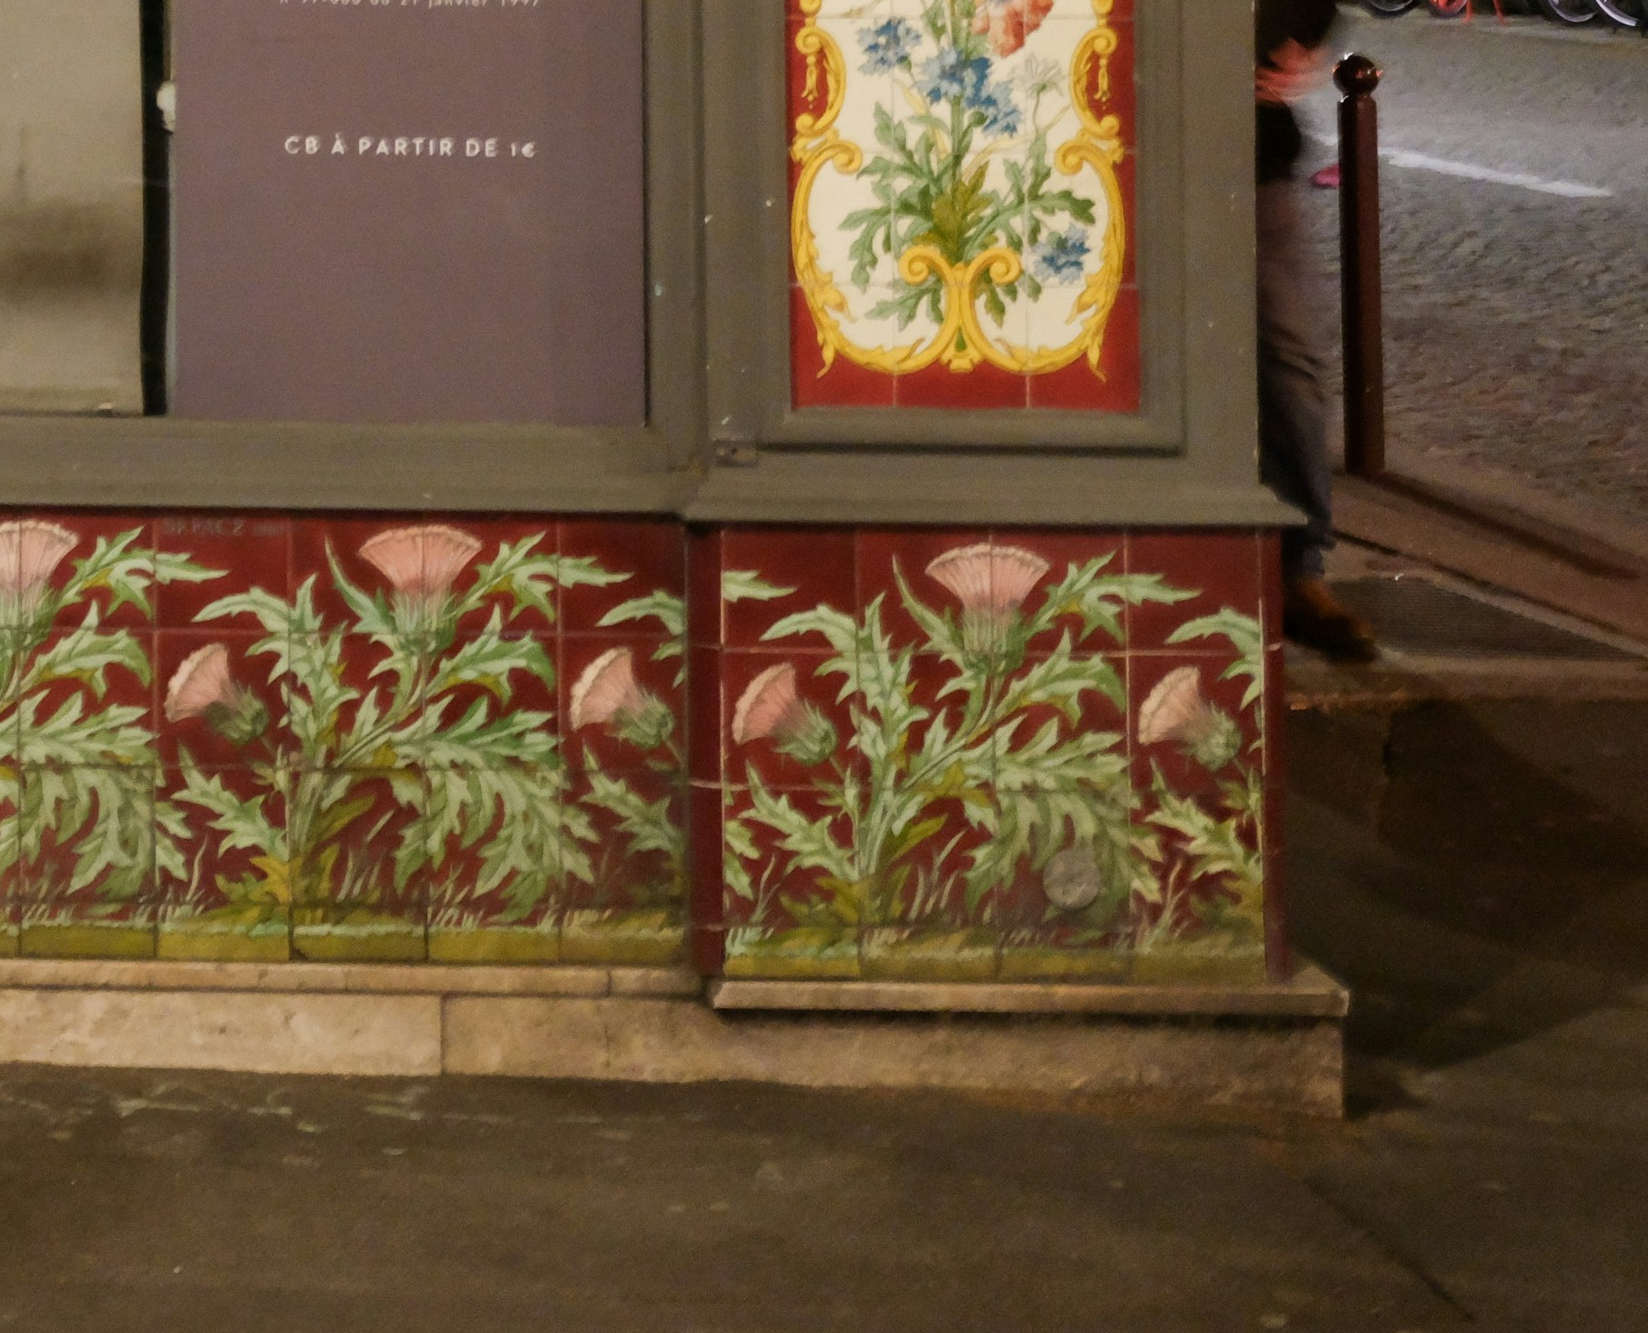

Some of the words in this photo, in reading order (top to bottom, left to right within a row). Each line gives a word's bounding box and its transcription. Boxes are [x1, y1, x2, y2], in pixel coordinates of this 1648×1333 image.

[283, 134, 321, 156] CB
[330, 132, 346, 156] À
[357, 135, 455, 158] PARTIR
[464, 137, 498, 159] DE
[509, 141, 538, 159] 1€
